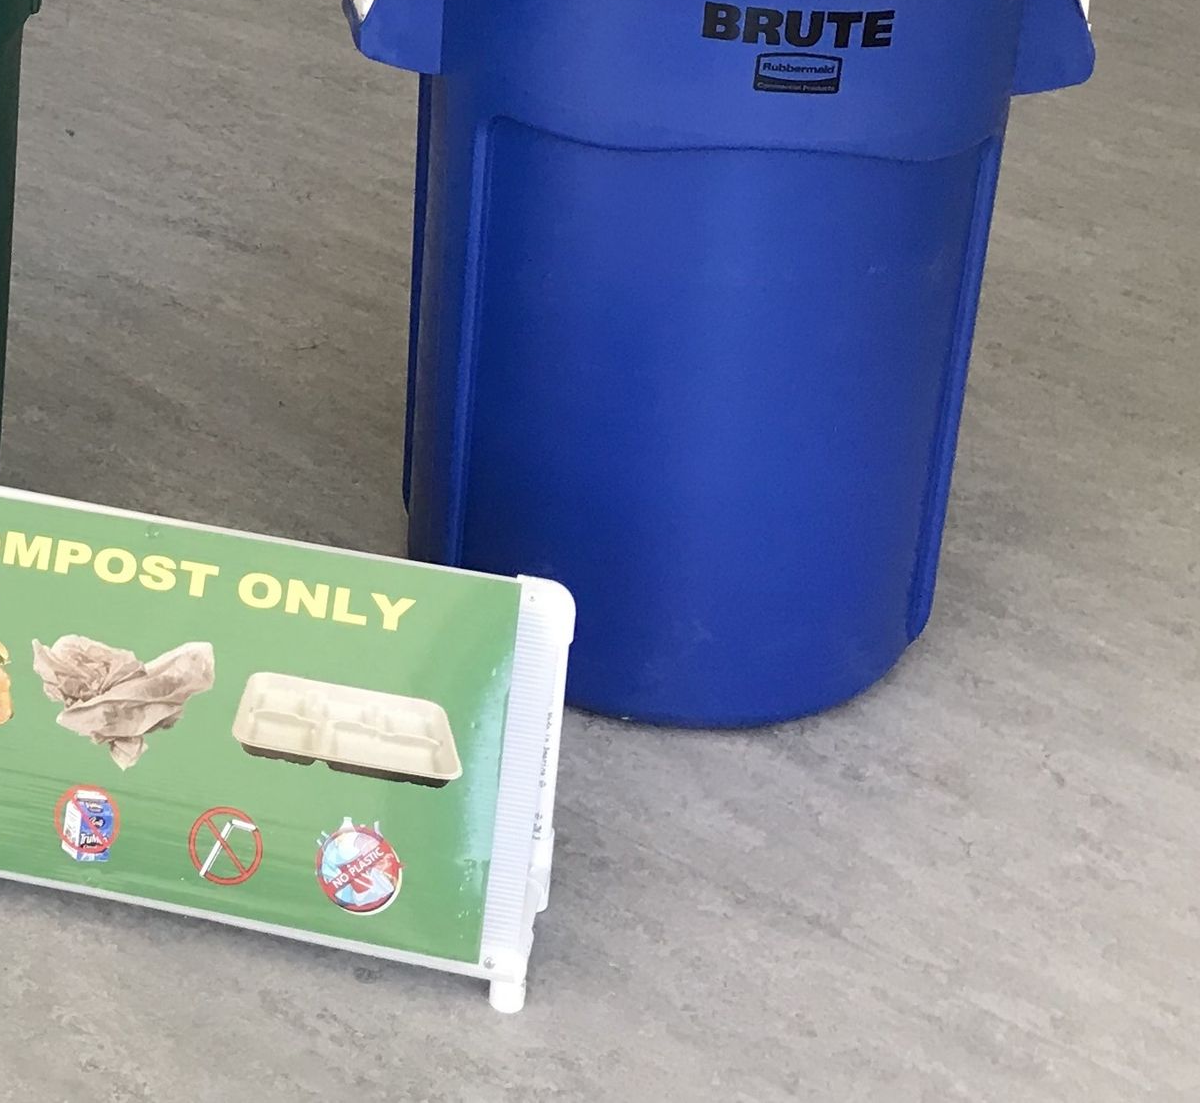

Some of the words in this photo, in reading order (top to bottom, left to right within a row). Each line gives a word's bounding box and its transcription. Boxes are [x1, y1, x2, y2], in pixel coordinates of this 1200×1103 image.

[702, 1, 896, 48] BRUTE
[762, 62, 836, 74] Rubbermaid
[238, 572, 416, 631] ONLY
[332, 873, 349, 888] NO
[348, 846, 385, 876] PLASTIC
